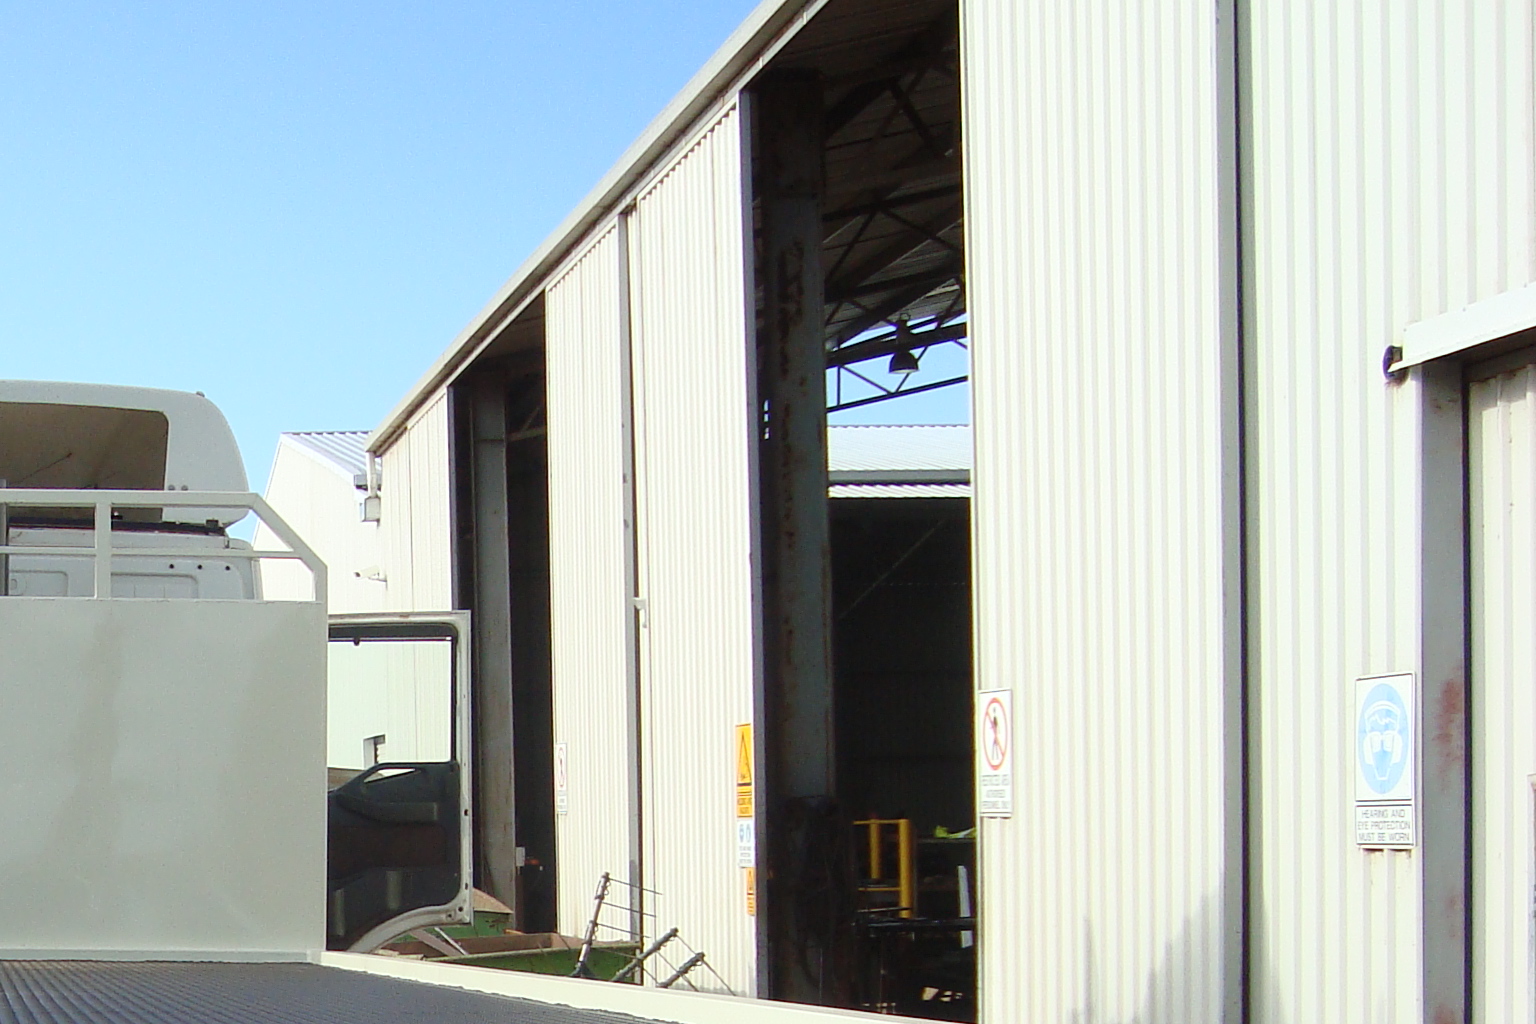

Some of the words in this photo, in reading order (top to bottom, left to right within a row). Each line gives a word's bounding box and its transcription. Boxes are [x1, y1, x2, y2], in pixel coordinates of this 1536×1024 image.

[1391, 809, 1406, 818] AND
[1358, 821, 1369, 830] EYE
[1371, 820, 1411, 830] PROTECTION
[1359, 832, 1375, 842] MUST
[1377, 832, 1386, 841] BE
[1388, 832, 1410, 841] WORN
